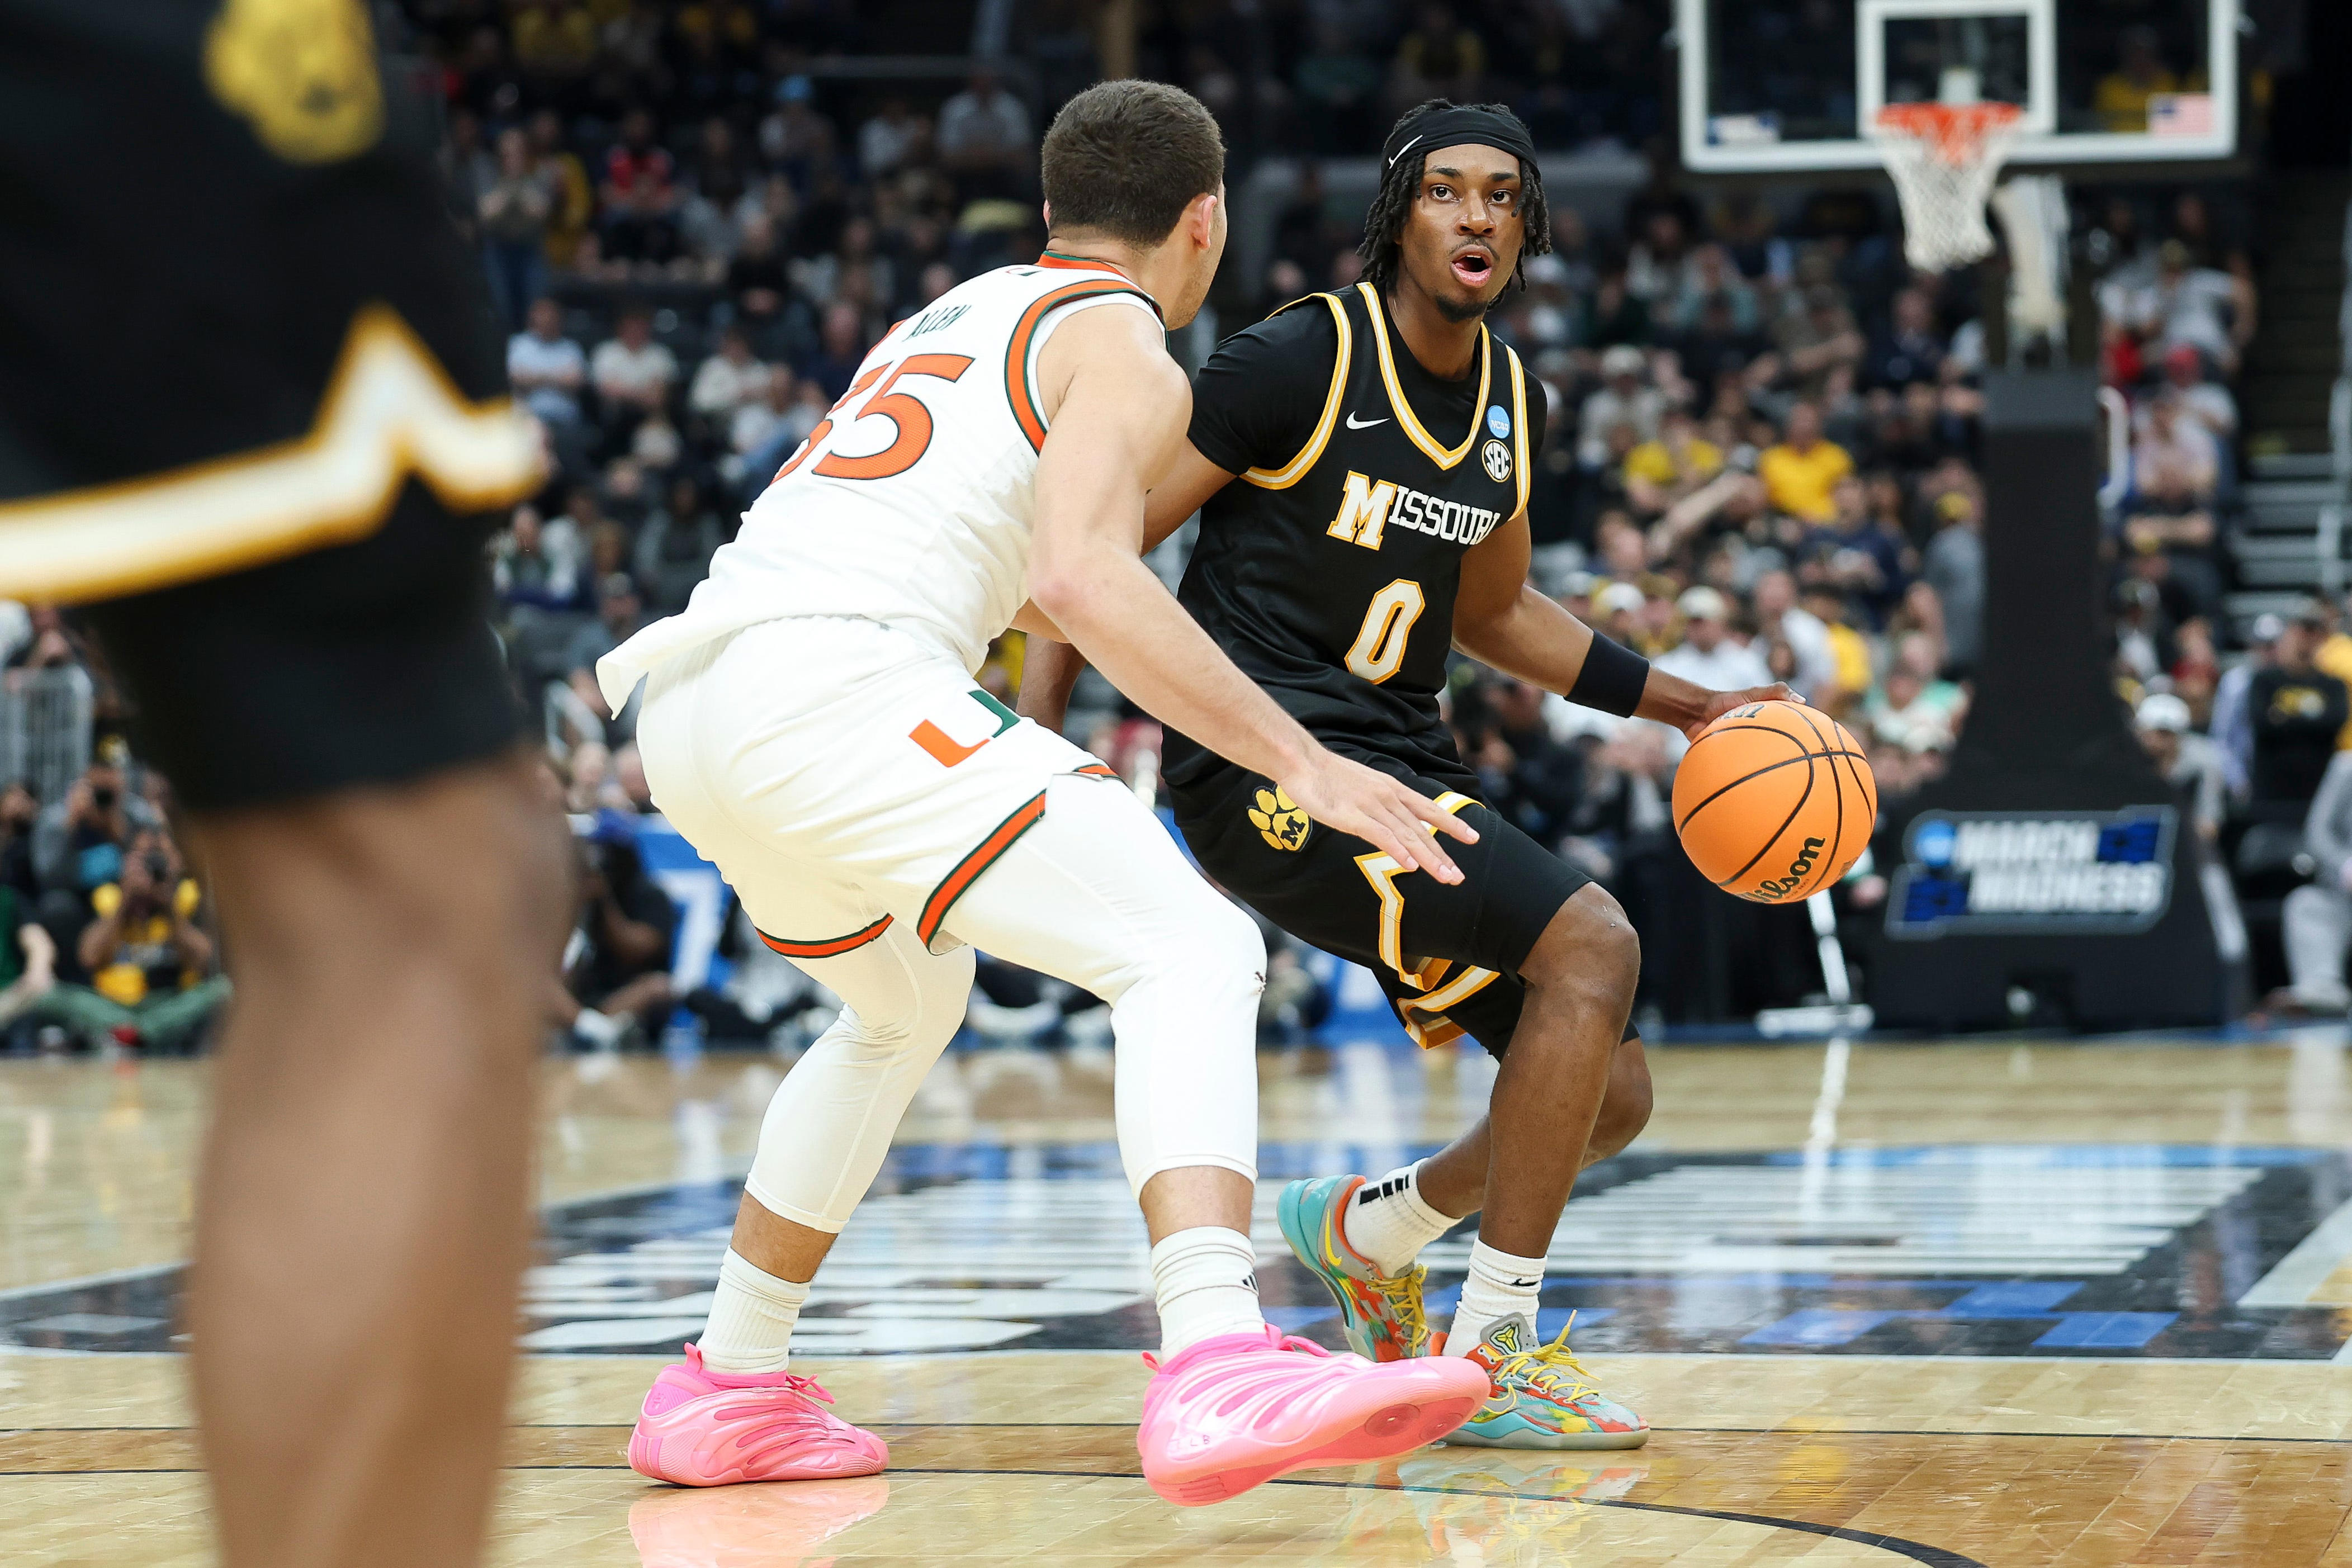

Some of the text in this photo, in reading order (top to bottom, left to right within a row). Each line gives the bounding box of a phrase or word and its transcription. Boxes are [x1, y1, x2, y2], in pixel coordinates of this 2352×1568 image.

[901, 304, 972, 342] ALLEN
[1490, 419, 1509, 433] NCAA
[1485, 441, 1510, 480] SEC
[1326, 470, 1501, 551] MISSOURI
[1343, 577, 1426, 685] 0
[1279, 814, 1306, 847] M
